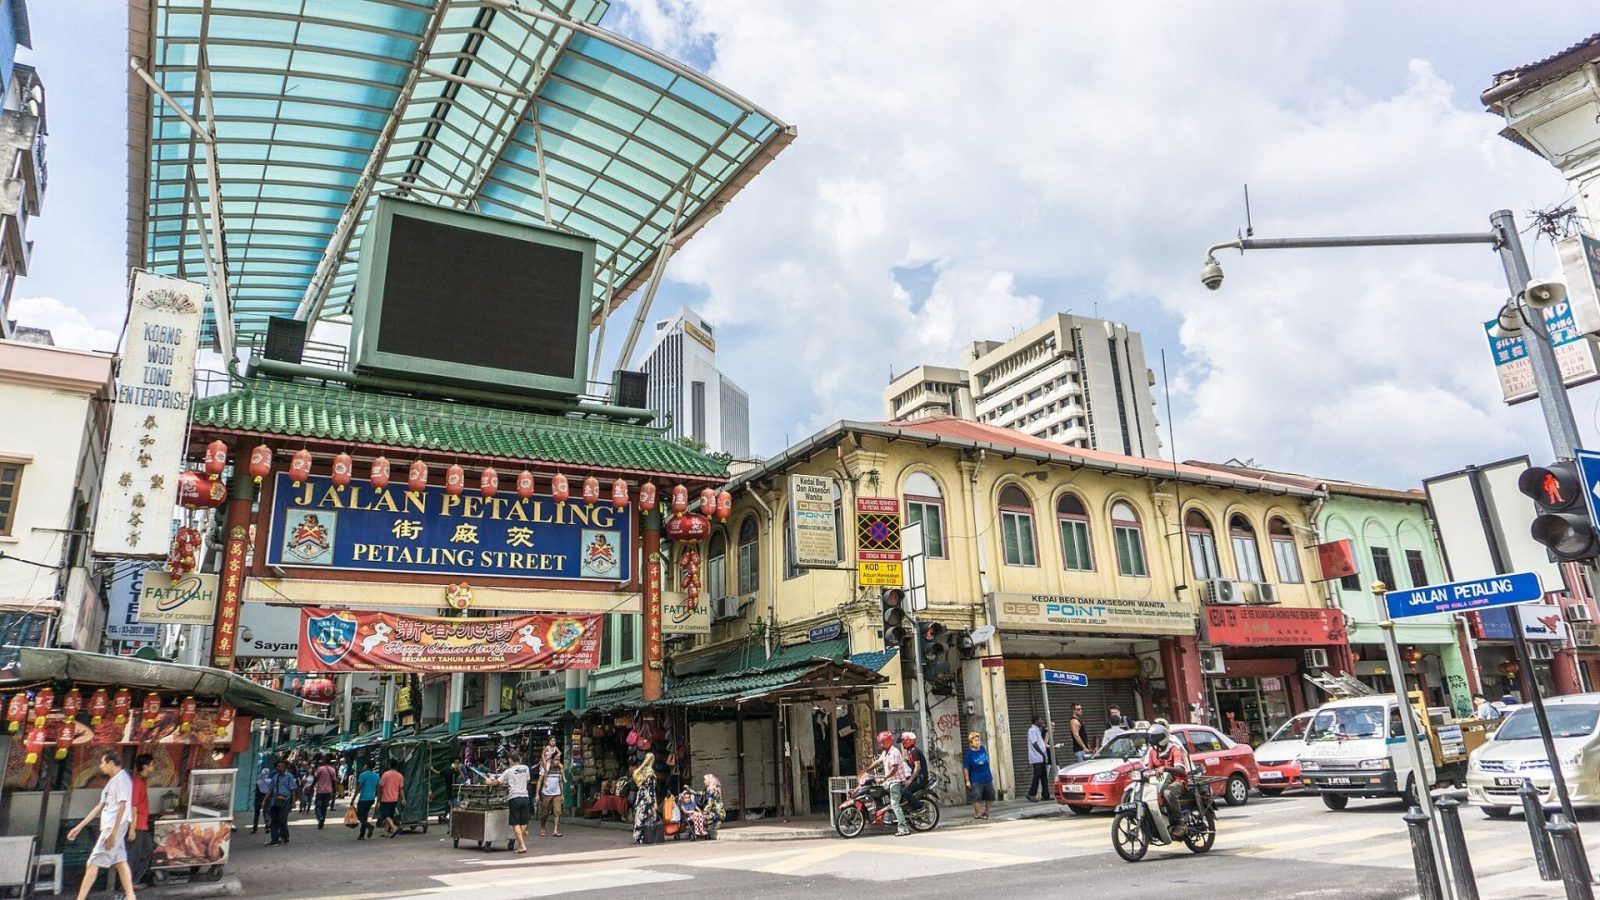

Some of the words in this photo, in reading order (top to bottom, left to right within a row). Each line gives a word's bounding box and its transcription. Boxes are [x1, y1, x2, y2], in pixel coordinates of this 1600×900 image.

[147, 344, 174, 365] WOH
[118, 385, 188, 410] ENTERPRISE
[294, 482, 428, 514] JALAN
[439, 494, 616, 528] PETALING
[805, 493, 823, 501] Wanita
[352, 543, 474, 567] PETALING
[480, 552, 567, 571] STREET
[1077, 597, 1094, 605] DAN
[1096, 599, 1135, 607] AKSESORI
[1138, 600, 1165, 608] WANITA
[1408, 588, 1448, 606] JALAN
[1454, 579, 1513, 599] PETALING
[664, 604, 707, 615] FATTAH
[383, 640, 425, 657] Happy
[427, 642, 469, 654] Chinese
[470, 641, 493, 654] New
[491, 641, 523, 657] Year
